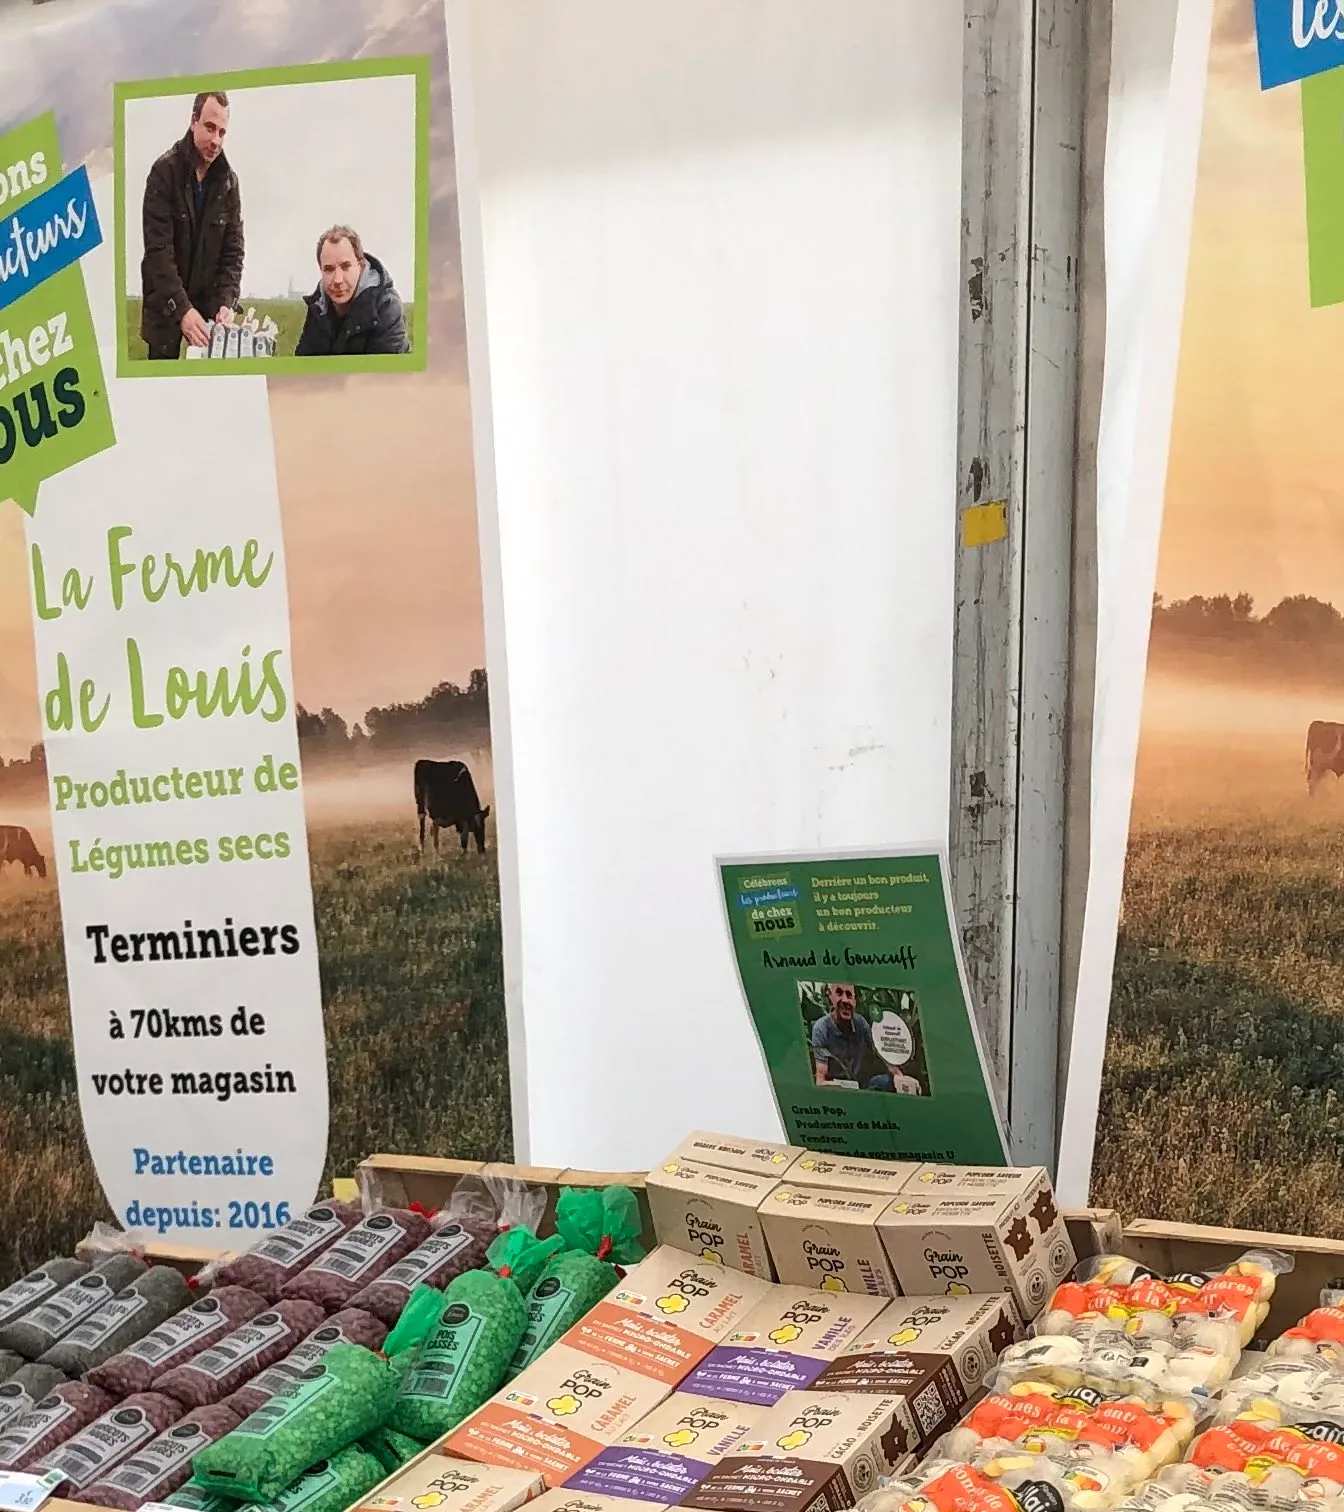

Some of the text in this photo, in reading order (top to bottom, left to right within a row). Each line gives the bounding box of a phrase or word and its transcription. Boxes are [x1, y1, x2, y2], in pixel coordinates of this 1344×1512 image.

[32, 526, 274, 620] La Ferme
[45, 638, 286, 732] de Louis
[54, 755, 298, 810] Producteur de
[70, 831, 290, 879] Légumes secs
[86, 918, 300, 963] Terminiers
[753, 916, 795, 932] nous
[763, 950, 817, 968] Arnaud
[822, 949, 840, 967] de
[109, 1006, 266, 1039] à 70kms de
[92, 1064, 297, 1101] votre magasin
[133, 1148, 274, 1176] Partenaire
[126, 1201, 291, 1233] depuis: 2016
[803, 1240, 840, 1258] Grain
[807, 1256, 845, 1273] POP
[590, 1394, 636, 1433] CARAMEL
[707, 1423, 750, 1457] VANILLE
